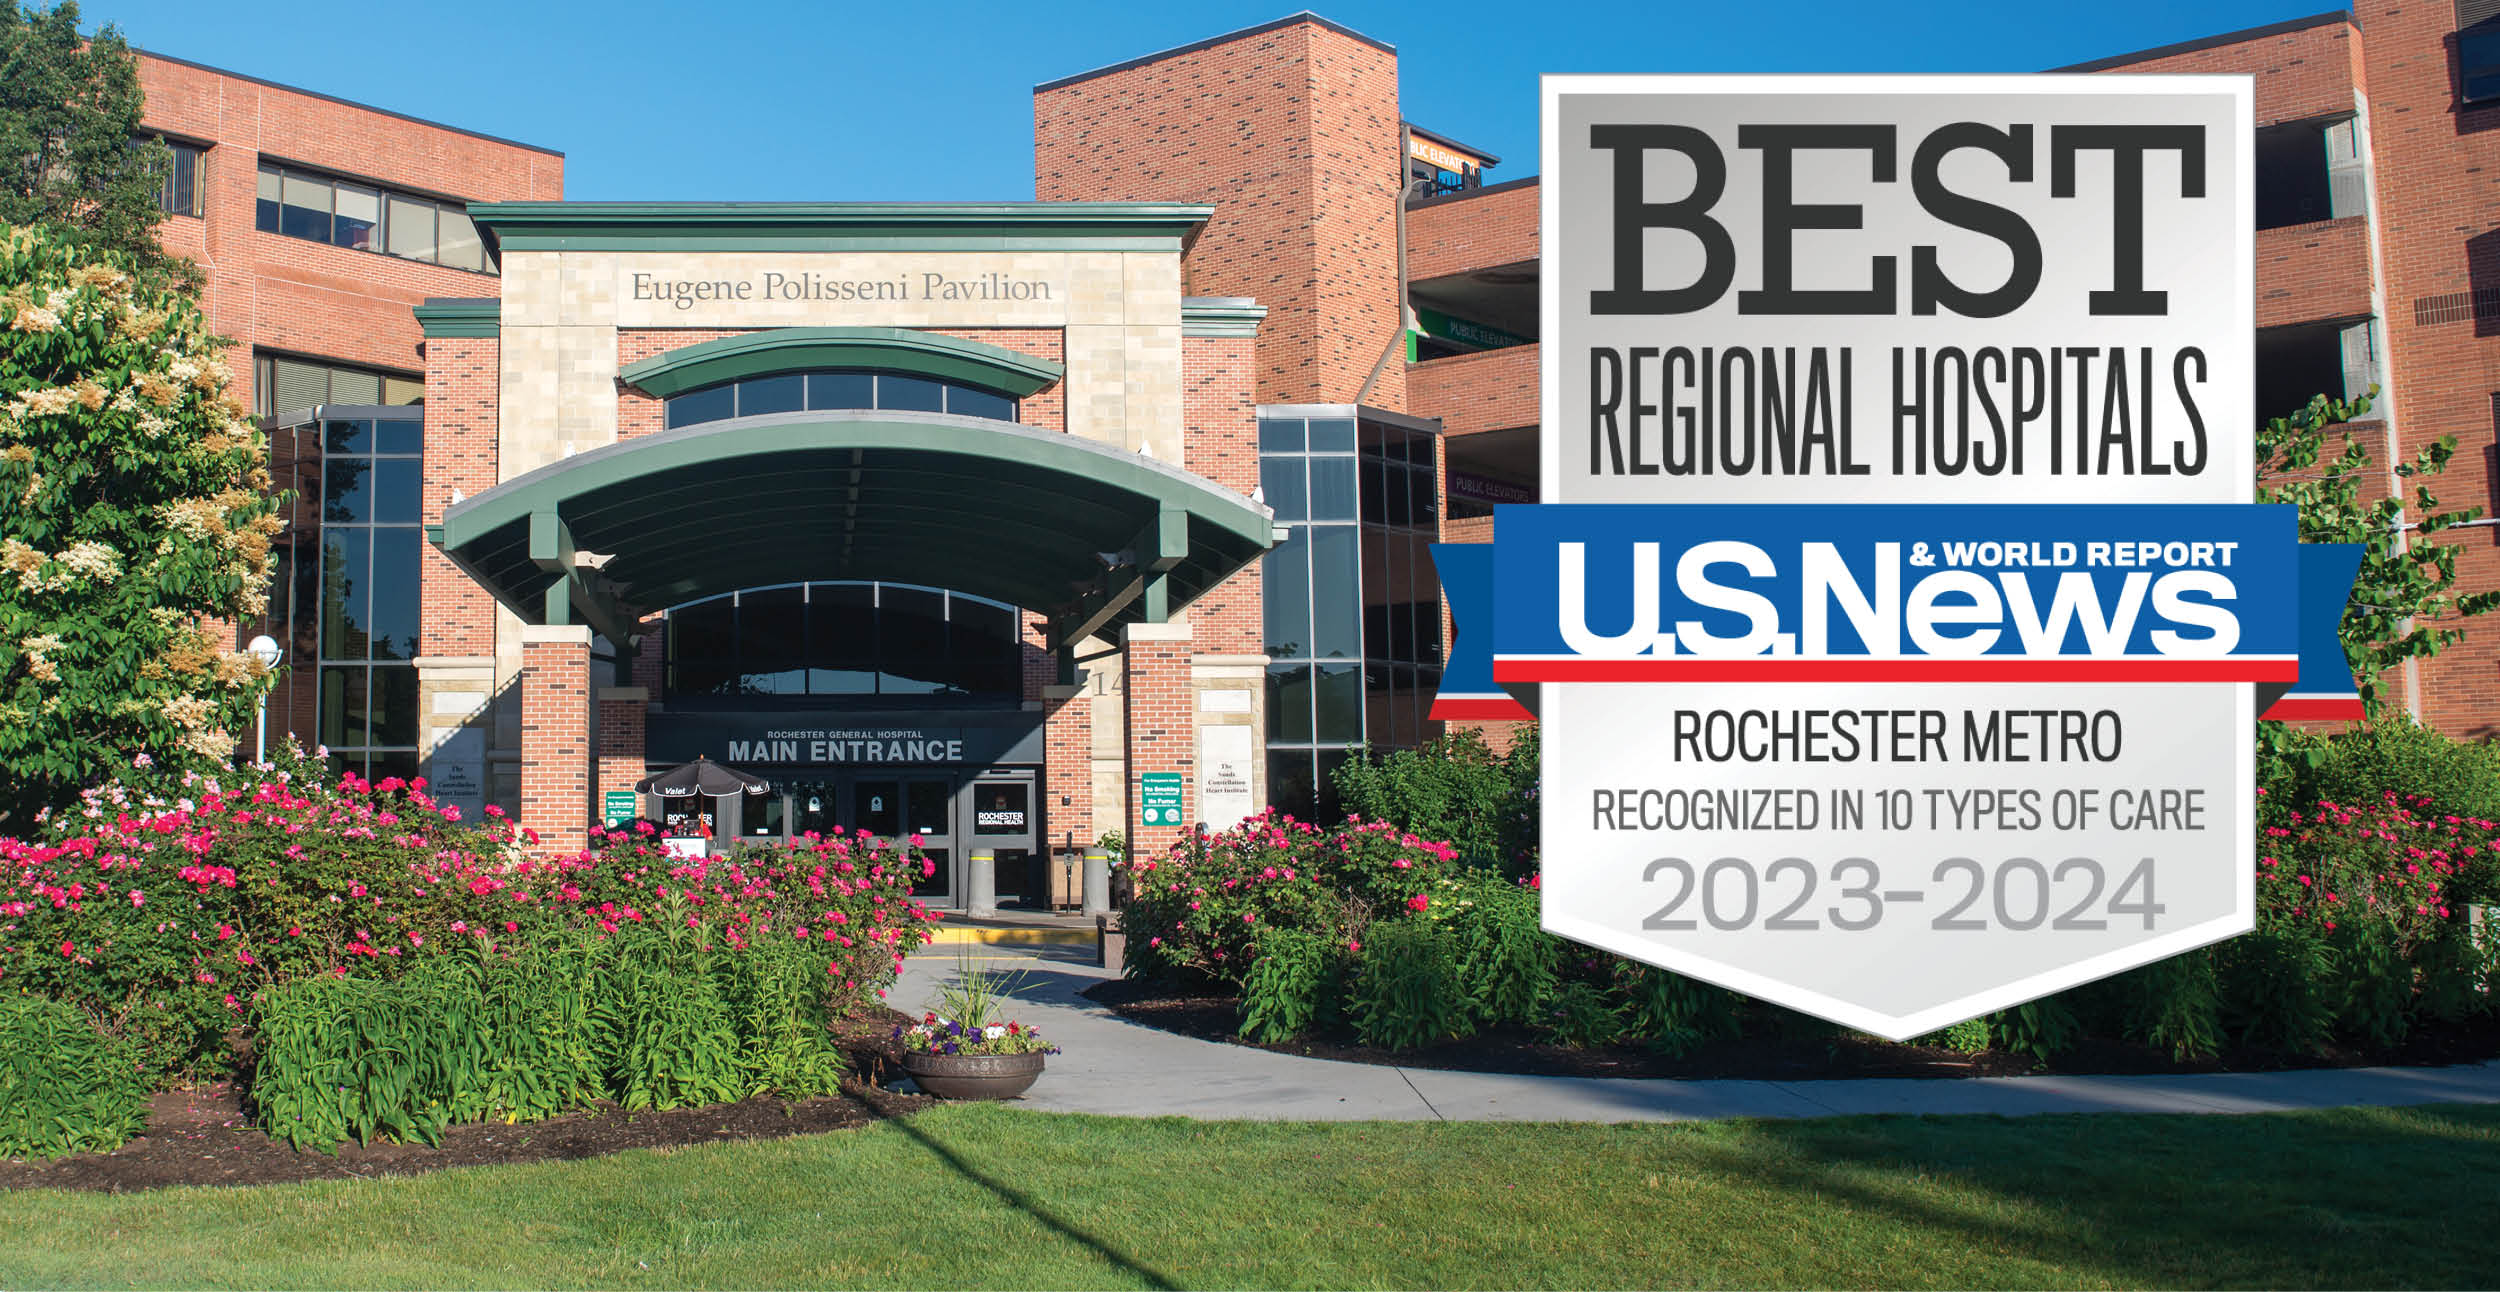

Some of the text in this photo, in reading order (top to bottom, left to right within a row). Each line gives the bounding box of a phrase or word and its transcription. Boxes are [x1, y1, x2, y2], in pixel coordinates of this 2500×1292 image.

[1410, 141, 1429, 158] BLIC
[632, 272, 1051, 310] Eugene Polisseni Pavilion
[1450, 319, 1479, 341] PUBLIC
[1456, 476, 1484, 495] PUBLIC
[767, 730, 923, 739] ROCHESTER GENERAL HOSPITAL
[728, 740, 962, 761] MAIN ENTRANCE
[665, 787, 686, 795] Valet
[978, 812, 1024, 820] ROCHESTER
